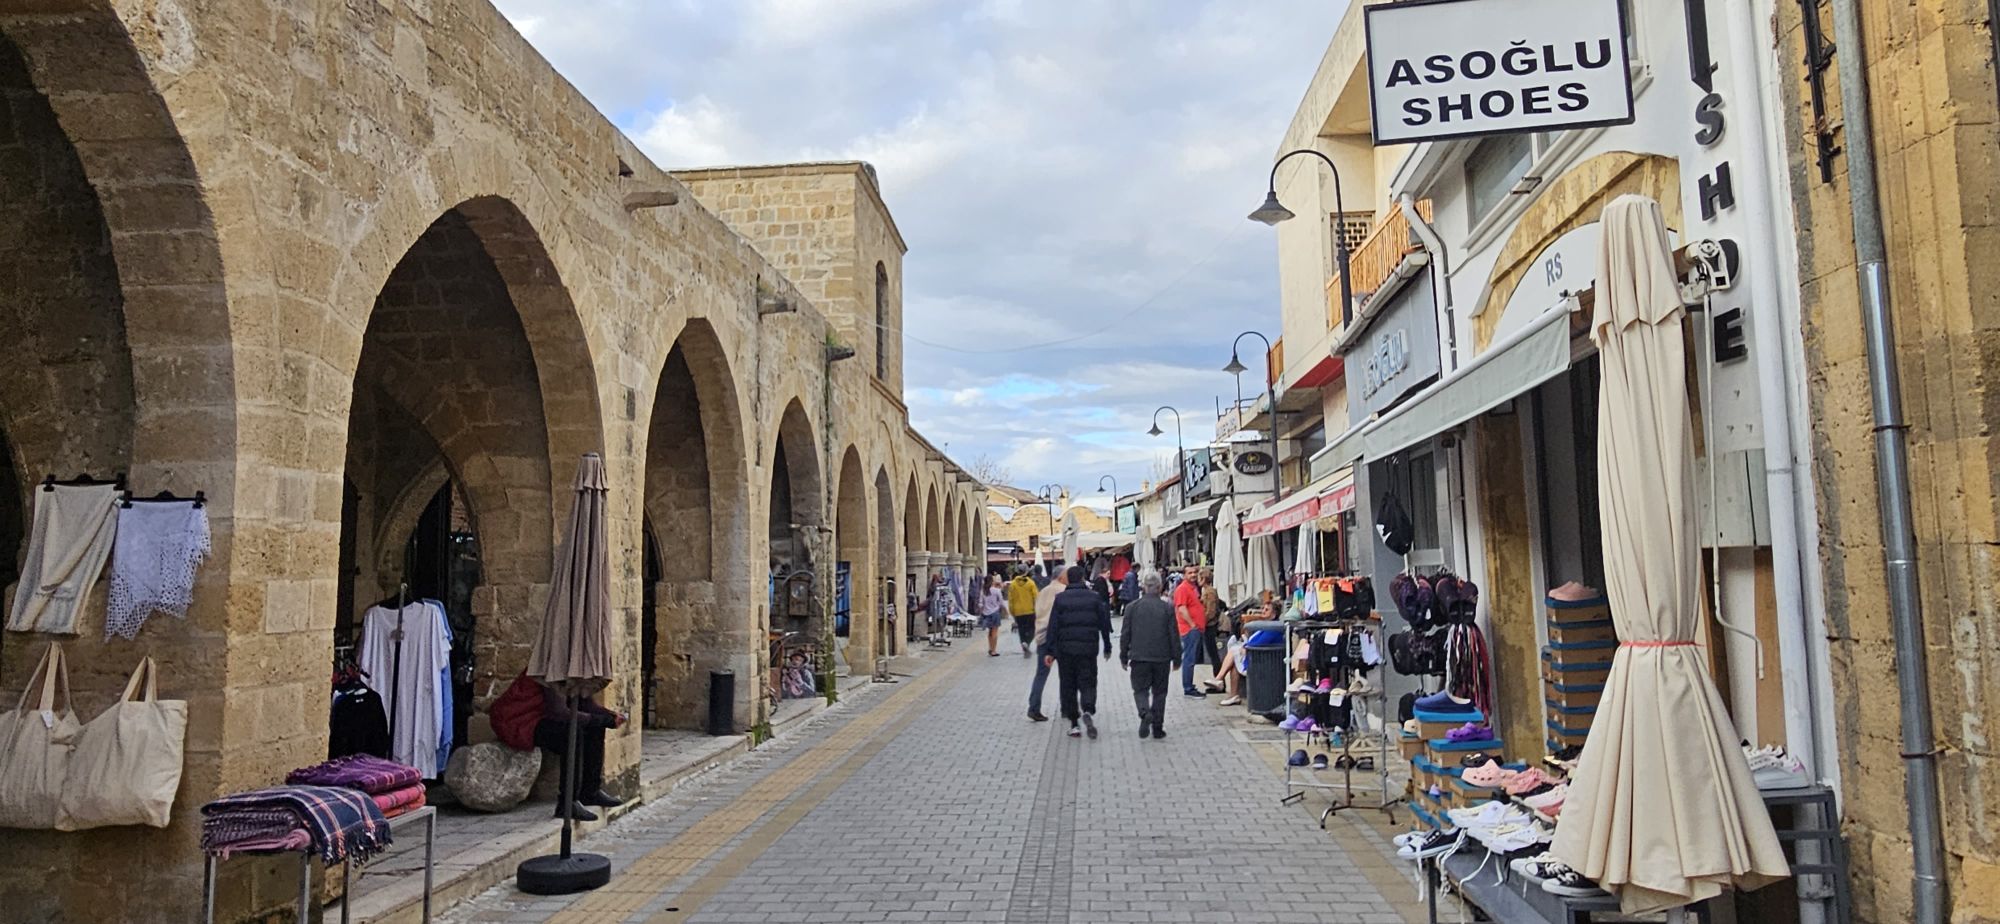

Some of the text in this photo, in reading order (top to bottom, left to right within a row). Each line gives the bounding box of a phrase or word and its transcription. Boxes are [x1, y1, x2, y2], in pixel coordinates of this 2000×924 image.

[1385, 39, 1612, 88] ASOĞLU
[1402, 82, 1589, 126] SHOES
[1545, 252, 1563, 287] RS
